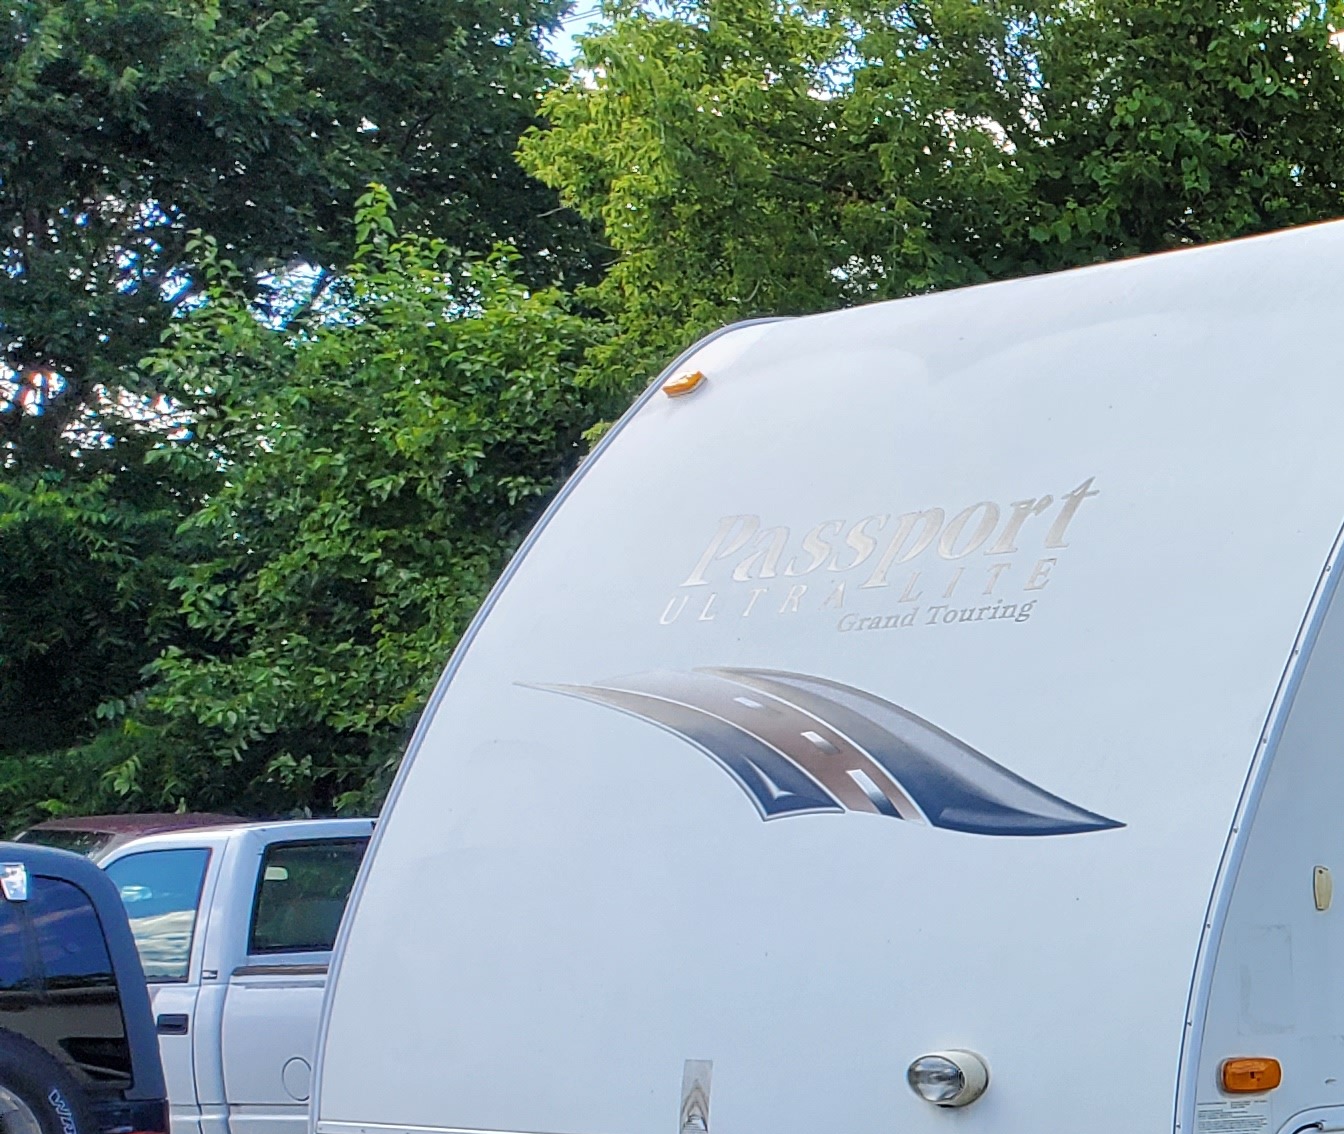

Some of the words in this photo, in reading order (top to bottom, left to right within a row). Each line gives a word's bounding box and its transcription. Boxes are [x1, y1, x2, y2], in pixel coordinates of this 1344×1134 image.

[681, 476, 1099, 588] Passport
[659, 580, 846, 625] ULTRA
[898, 558, 1057, 603] LITE
[837, 612, 915, 633] Grand
[927, 600, 1037, 625] Touring
